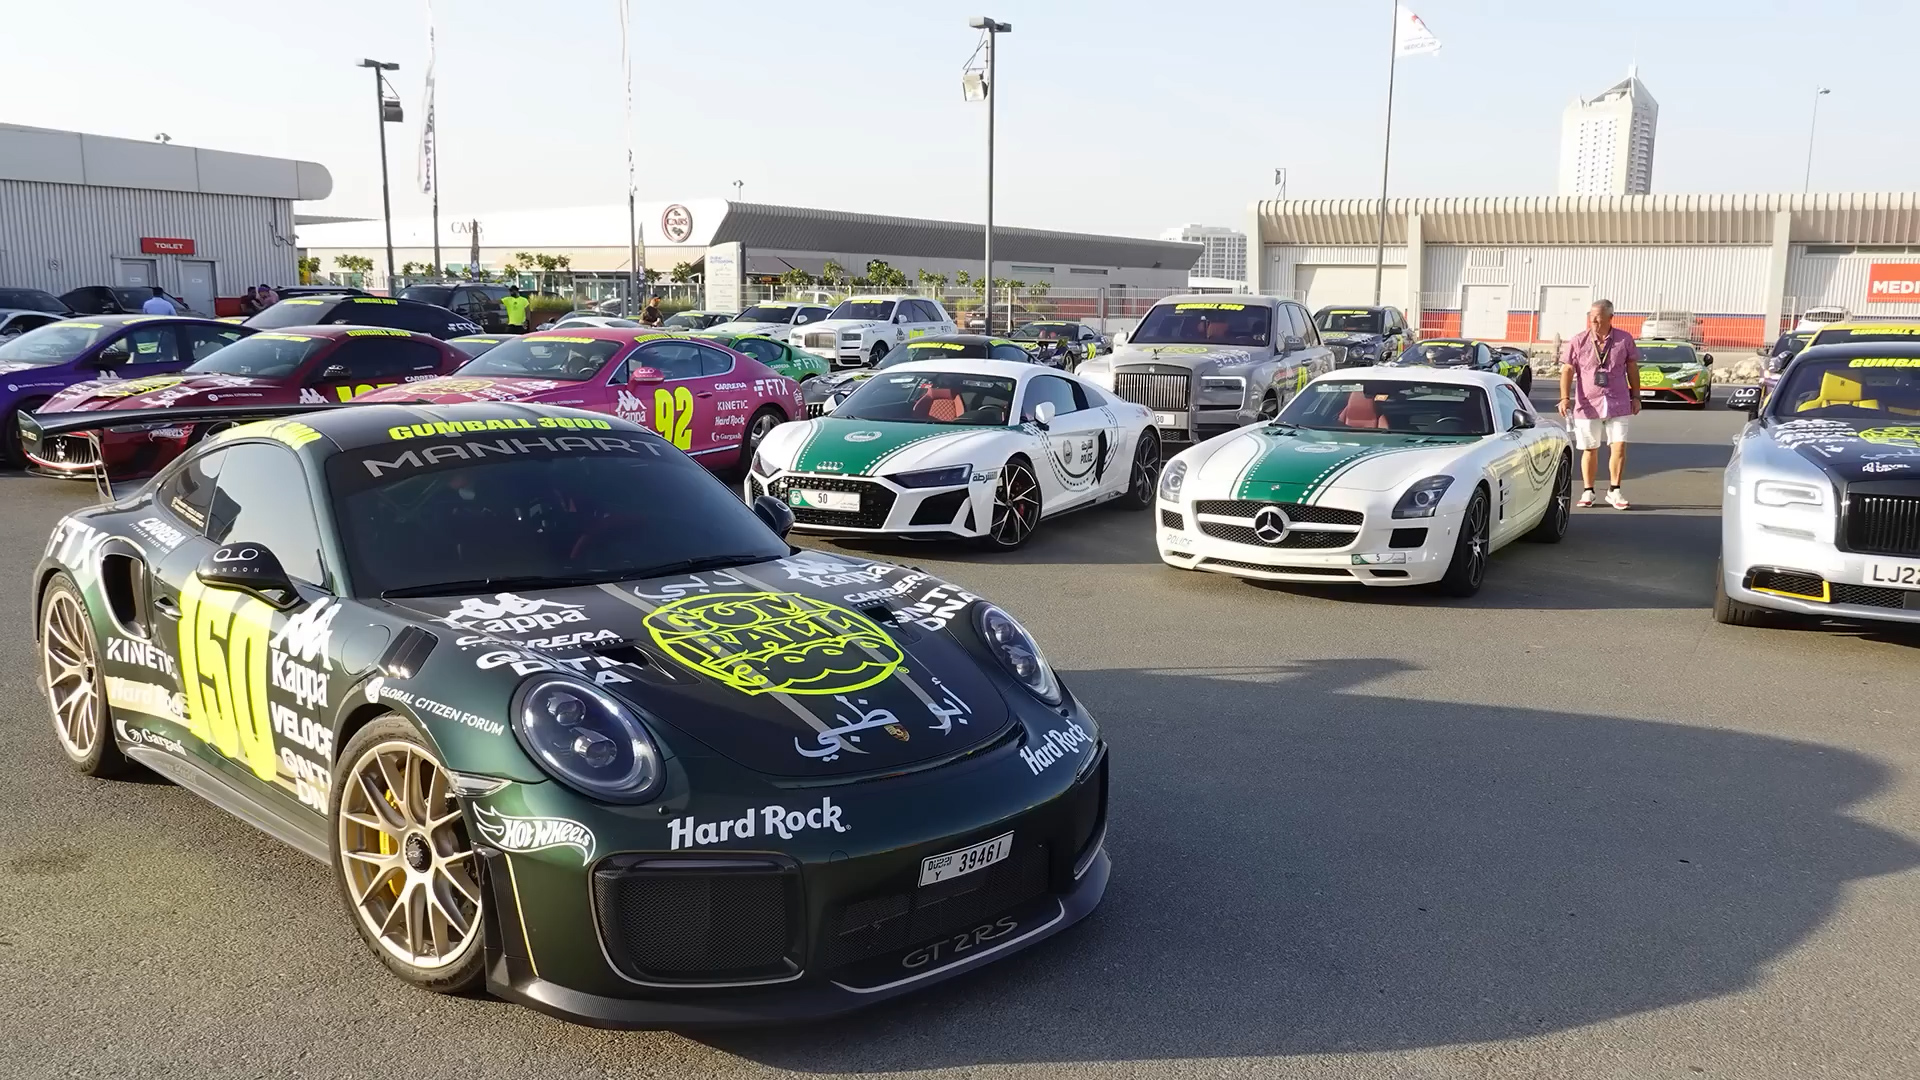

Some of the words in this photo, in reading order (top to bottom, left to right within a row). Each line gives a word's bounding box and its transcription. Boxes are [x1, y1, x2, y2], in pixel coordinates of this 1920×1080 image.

[802, 358, 821, 369] FTX
[715, 382, 747, 390] CARRERA
[766, 379, 789, 396] FTX
[618, 409, 646, 422] Kappa
[654, 386, 694, 450] 92
[717, 400, 748, 411] KINETIC
[388, 417, 537, 441] GUMBALL
[537, 417, 612, 430] 3000
[715, 416, 730, 426] Hard
[730, 415, 745, 426] Rock
[362, 436, 662, 478] MANHART
[817, 493, 828, 504] 50
[48, 515, 111, 574] FTX
[138, 517, 187, 548] CARRERA
[204, 566, 260, 574] ONDON
[1376, 554, 1381, 562] 5
[801, 565, 896, 588] Kappa
[107, 637, 178, 680] KINETIC
[110, 676, 154, 701] Hard
[178, 570, 277, 782] 150
[272, 649, 329, 710] Kappa
[380, 686, 415, 704] GLOBAL
[415, 697, 462, 721] CITIZEN
[460, 712, 505, 736] FORUM
[270, 701, 333, 762] VELOCE
[1020, 738, 1054, 776] Hard
[1052, 719, 1095, 754] Rock
[667, 808, 756, 850] Hard
[760, 797, 847, 840] Rock
[958, 841, 1003, 872] 39461
[935, 871, 941, 881] Y
[902, 938, 950, 968] GT
